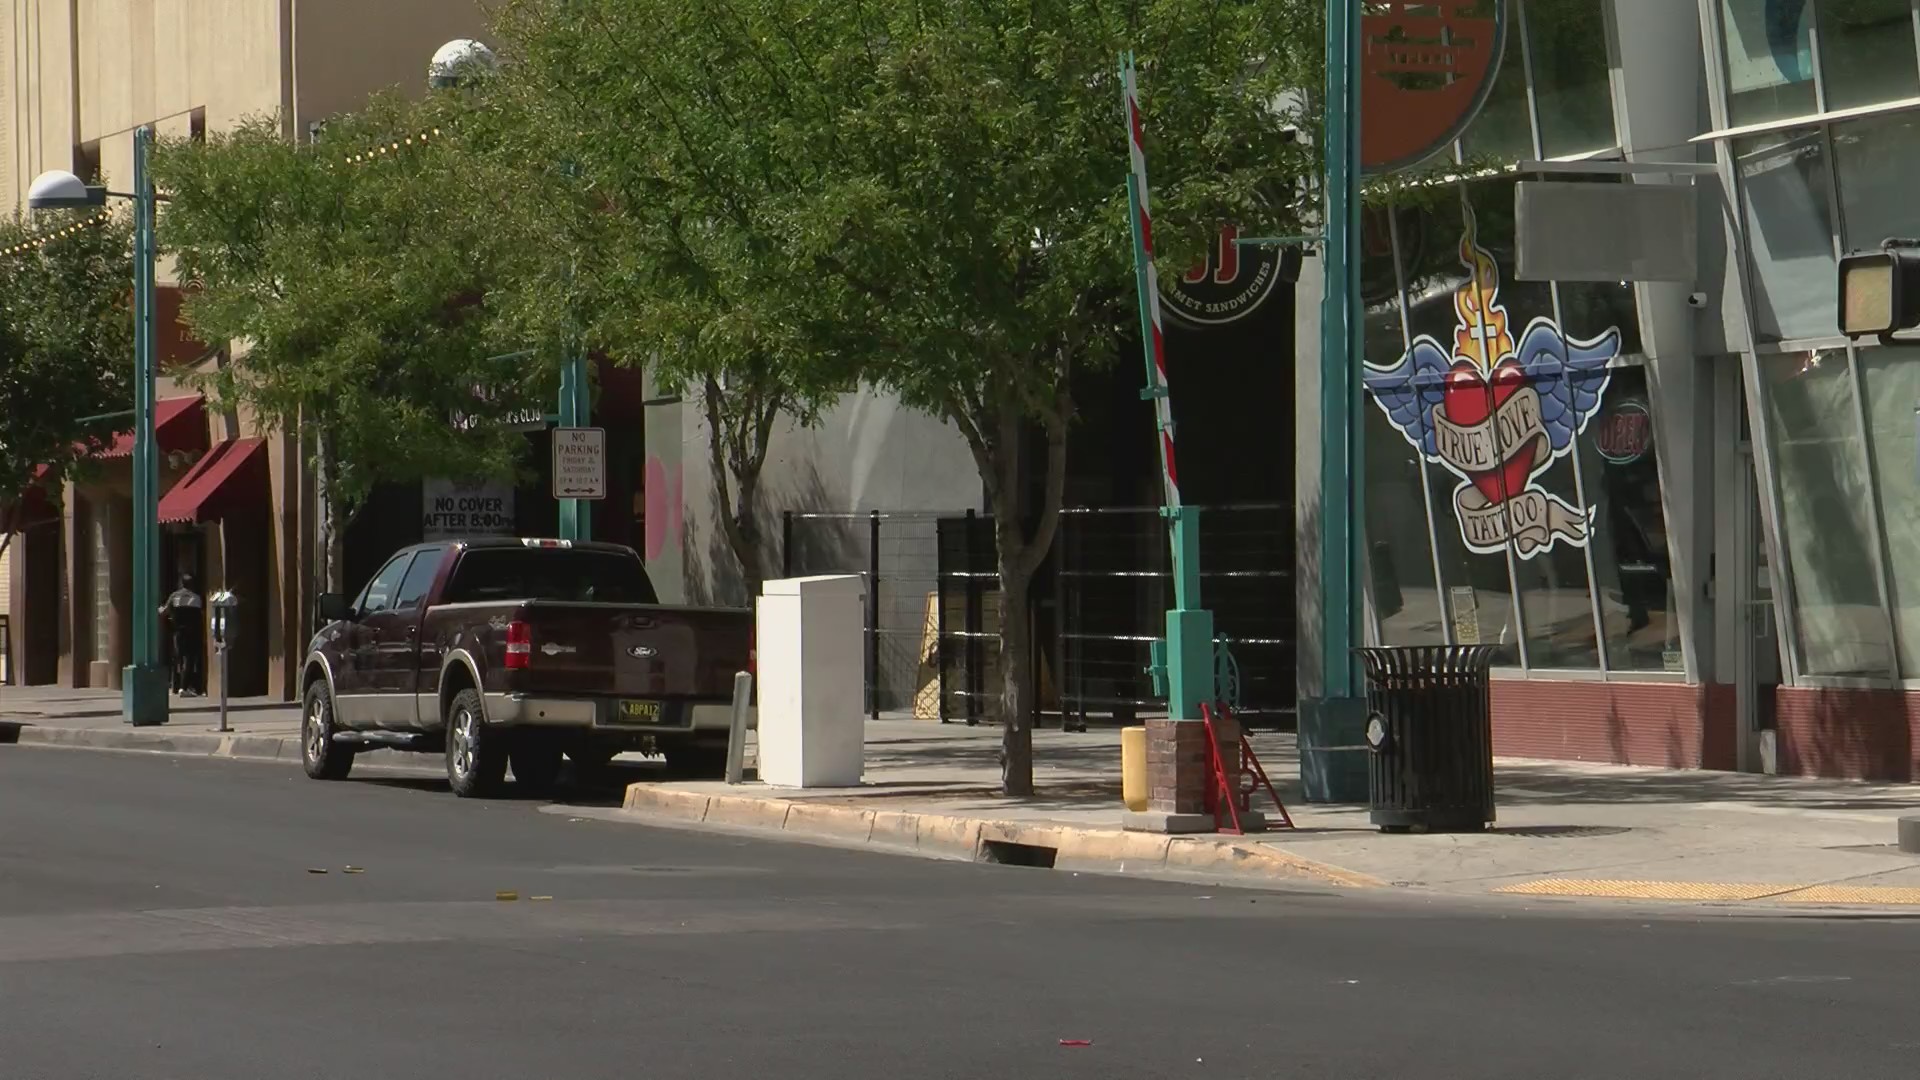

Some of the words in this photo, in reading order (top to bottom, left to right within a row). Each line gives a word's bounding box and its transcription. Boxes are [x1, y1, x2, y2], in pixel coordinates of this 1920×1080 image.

[1205, 260, 1271, 313] SANDWICHES
[572, 432, 586, 442] NO
[1437, 419, 1488, 466] TRUE
[1485, 395, 1537, 459] LOVE
[1599, 413, 1649, 453] OPEN
[558, 444, 600, 455] PARKING
[435, 497, 455, 512] NO
[458, 497, 503, 512] COVER
[423, 512, 467, 527] AFTER
[1467, 496, 1538, 541] TATTOO
